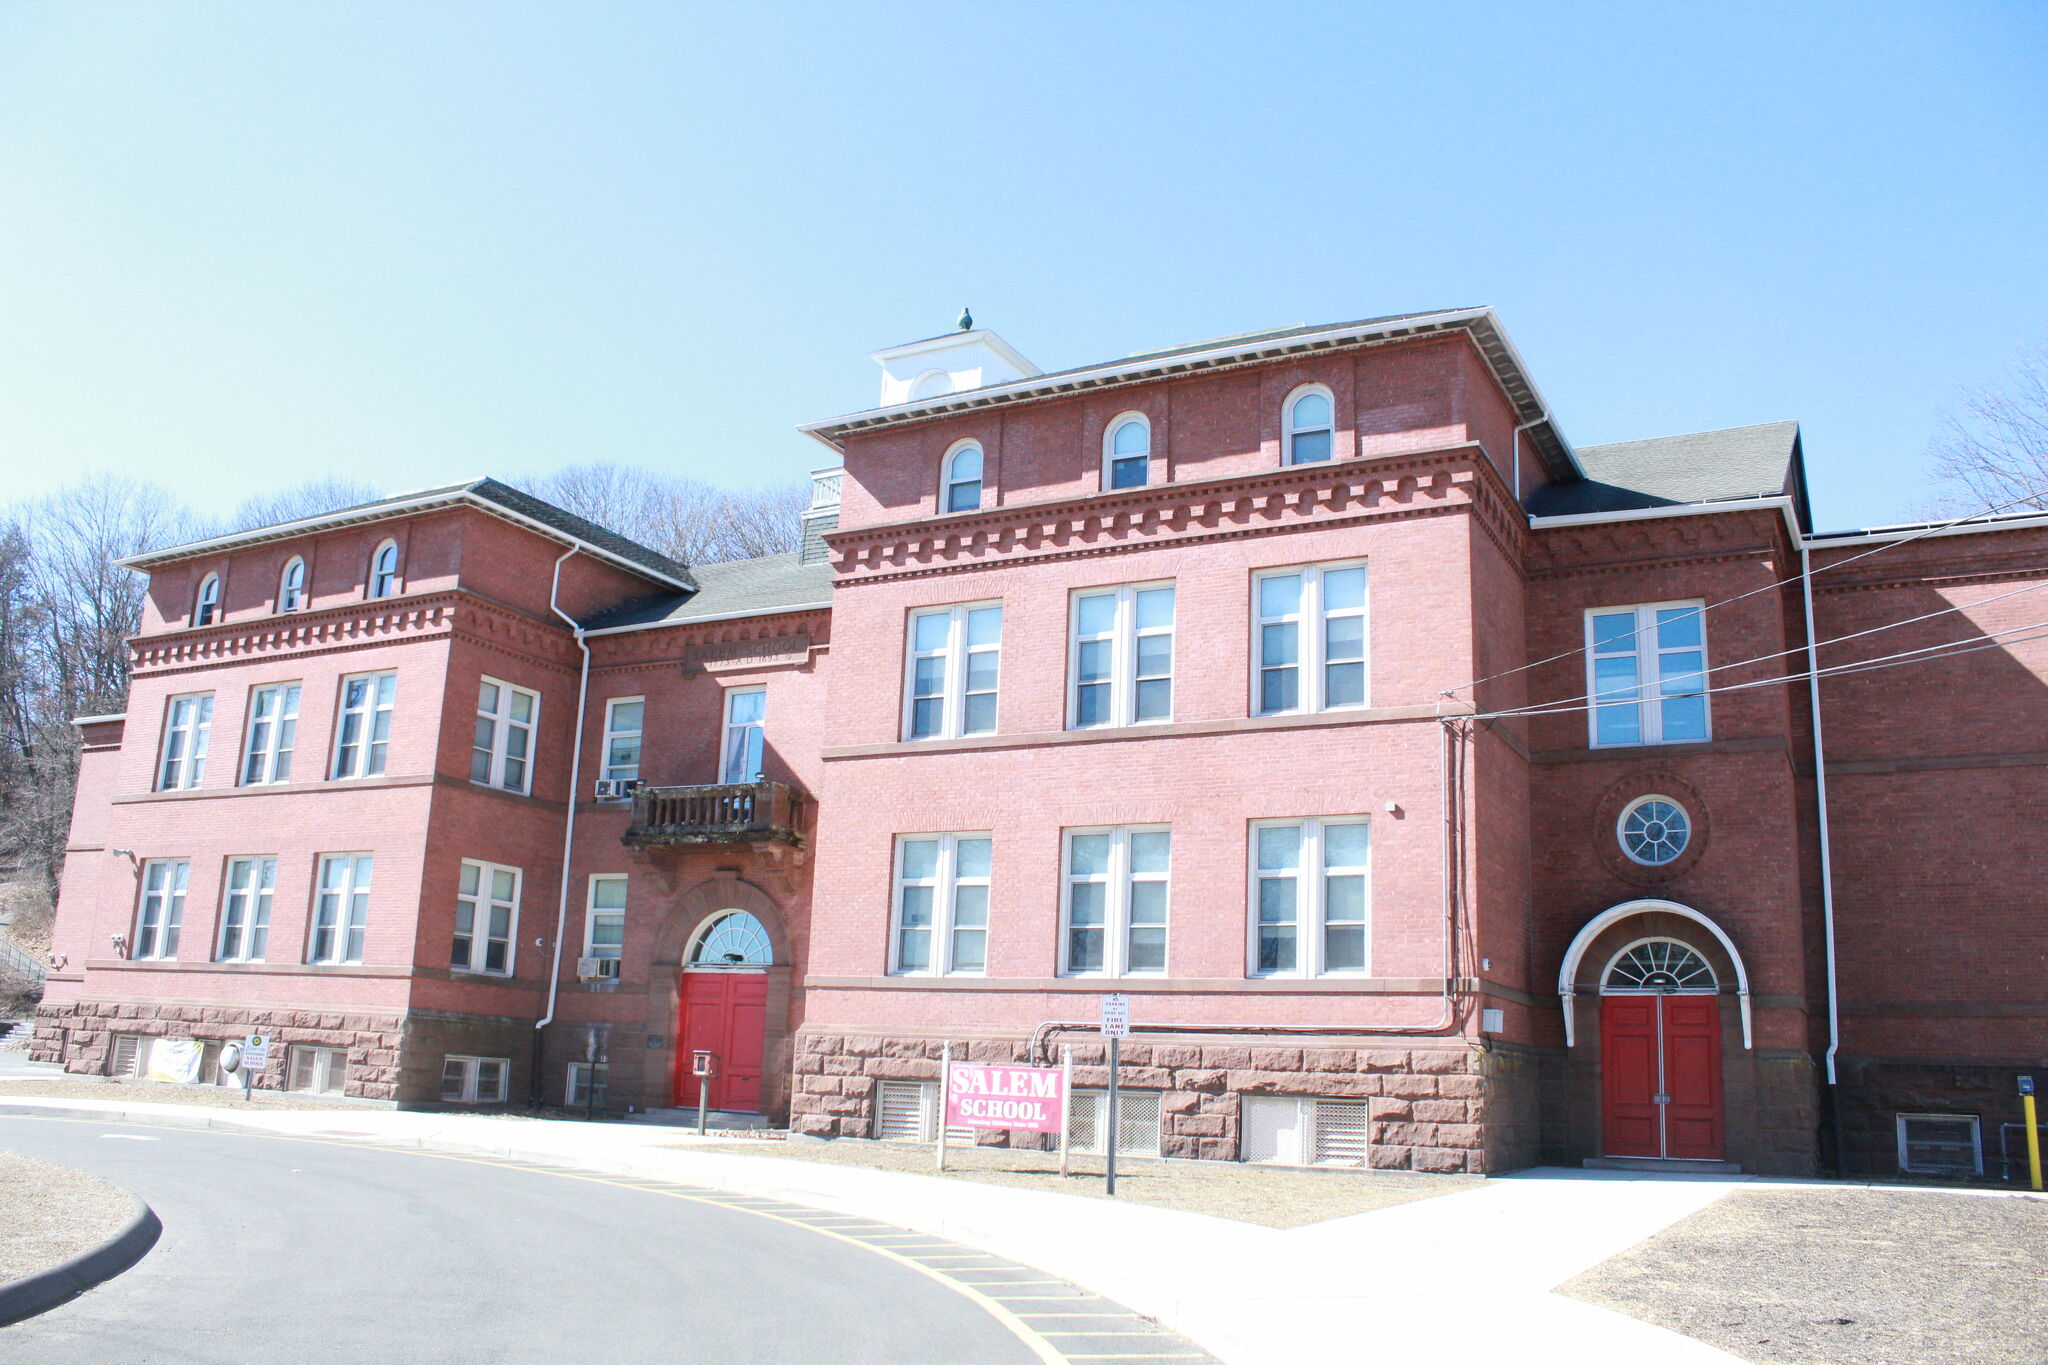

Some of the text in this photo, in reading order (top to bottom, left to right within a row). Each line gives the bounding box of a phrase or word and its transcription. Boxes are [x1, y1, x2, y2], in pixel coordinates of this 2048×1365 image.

[693, 640, 798, 661] SALEM SCHOOL
[952, 1068, 1058, 1098] SALEM
[960, 1098, 1046, 1121] SCHOOL
